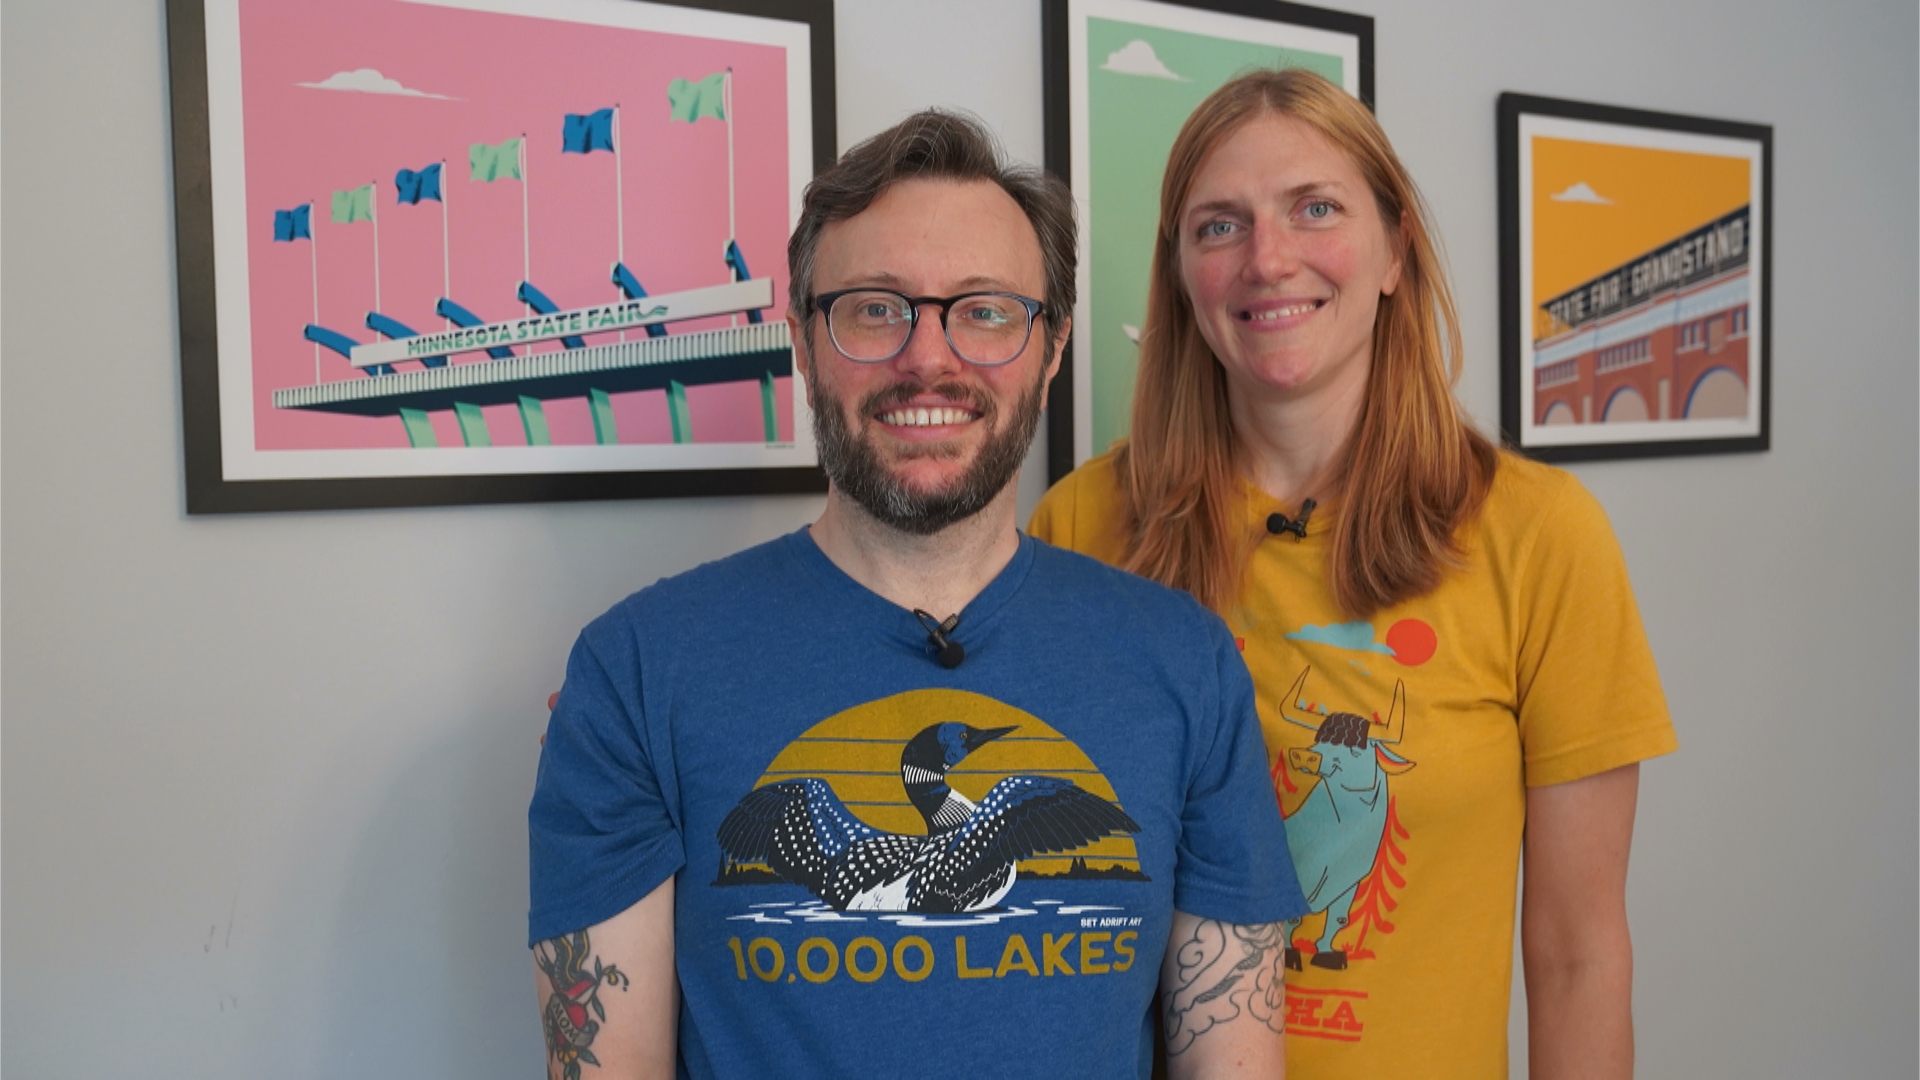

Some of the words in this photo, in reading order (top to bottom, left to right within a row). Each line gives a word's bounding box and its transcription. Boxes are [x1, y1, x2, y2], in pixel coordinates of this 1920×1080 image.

[1590, 275, 1621, 311] FAIR
[1631, 219, 1744, 296] GRANDSTAND
[407, 324, 512, 356] MINNESOTA
[517, 313, 582, 338] STATE
[588, 303, 650, 329] FAIR
[1100, 917, 1128, 928] ADRIFT
[1128, 916, 1143, 927] ART
[728, 935, 935, 983] 10,000
[955, 931, 1139, 979] LAKES
[552, 1004, 579, 1043] MOM
